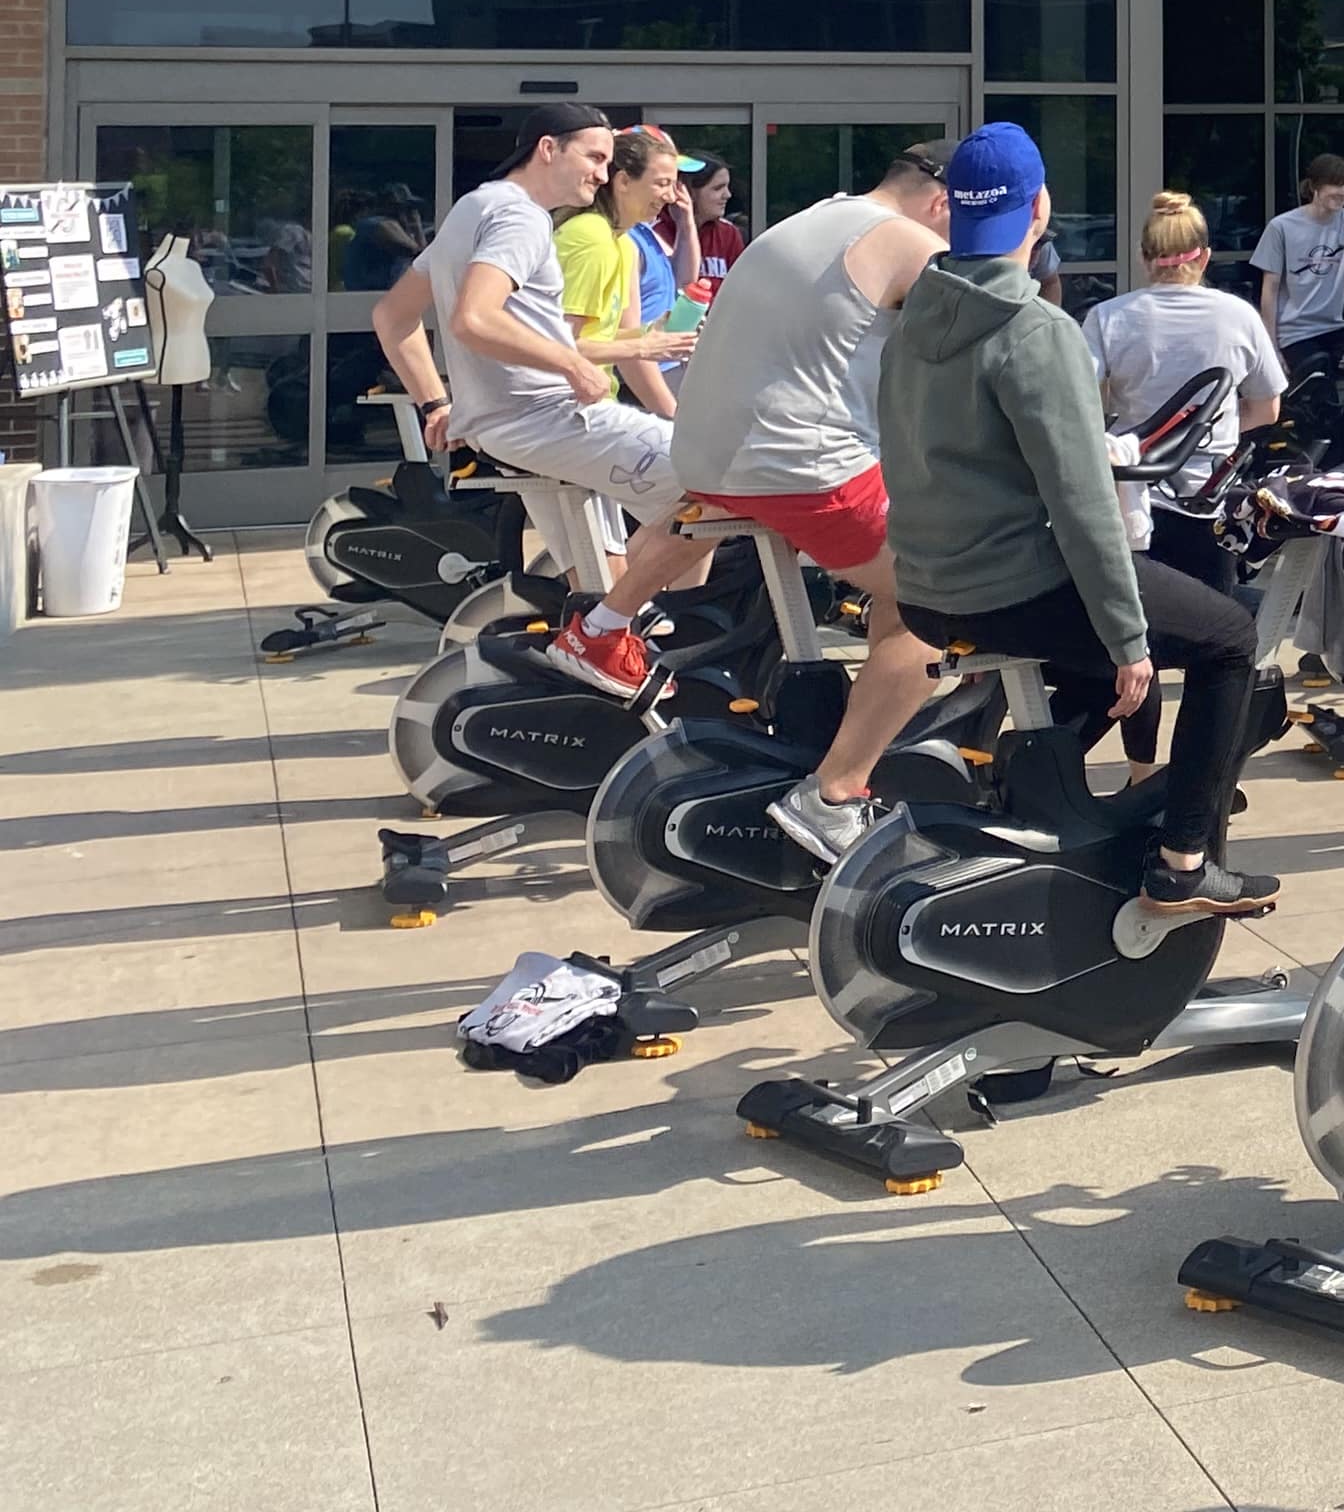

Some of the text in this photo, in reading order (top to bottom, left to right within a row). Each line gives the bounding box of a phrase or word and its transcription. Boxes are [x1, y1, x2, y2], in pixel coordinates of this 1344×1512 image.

[348, 545, 402, 561] MATRIX
[490, 727, 586, 748] MATRIX
[940, 922, 1046, 937] MATRIX
